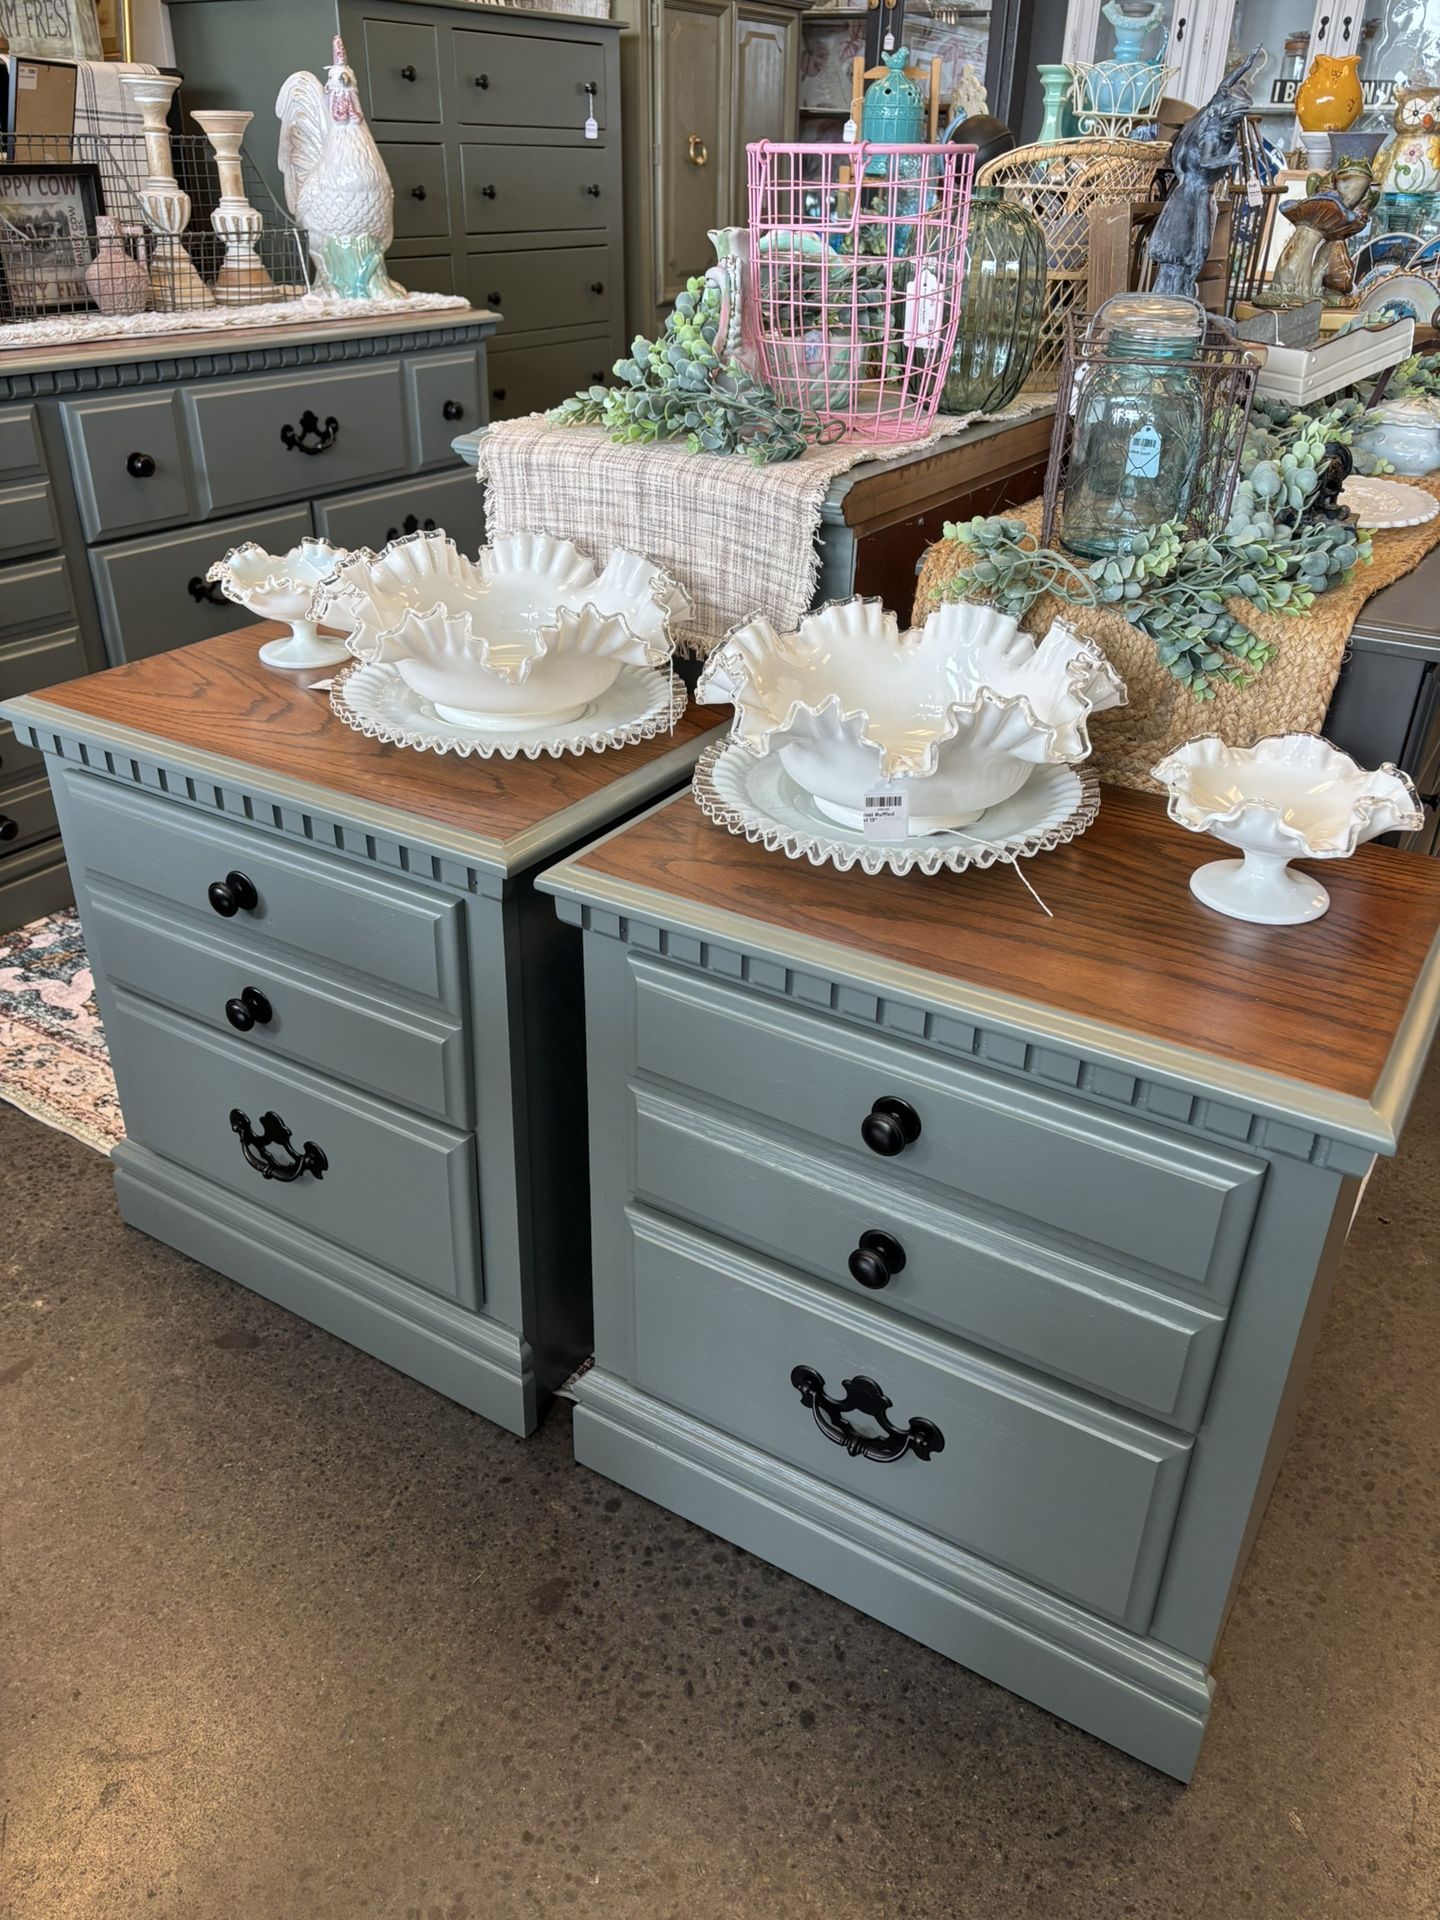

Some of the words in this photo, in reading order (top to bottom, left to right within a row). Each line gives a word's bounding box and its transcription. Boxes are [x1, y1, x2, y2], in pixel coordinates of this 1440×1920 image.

[1273, 81, 1281, 102] I
[37, 175, 77, 196] COW
[68, 206, 79, 232] COW
